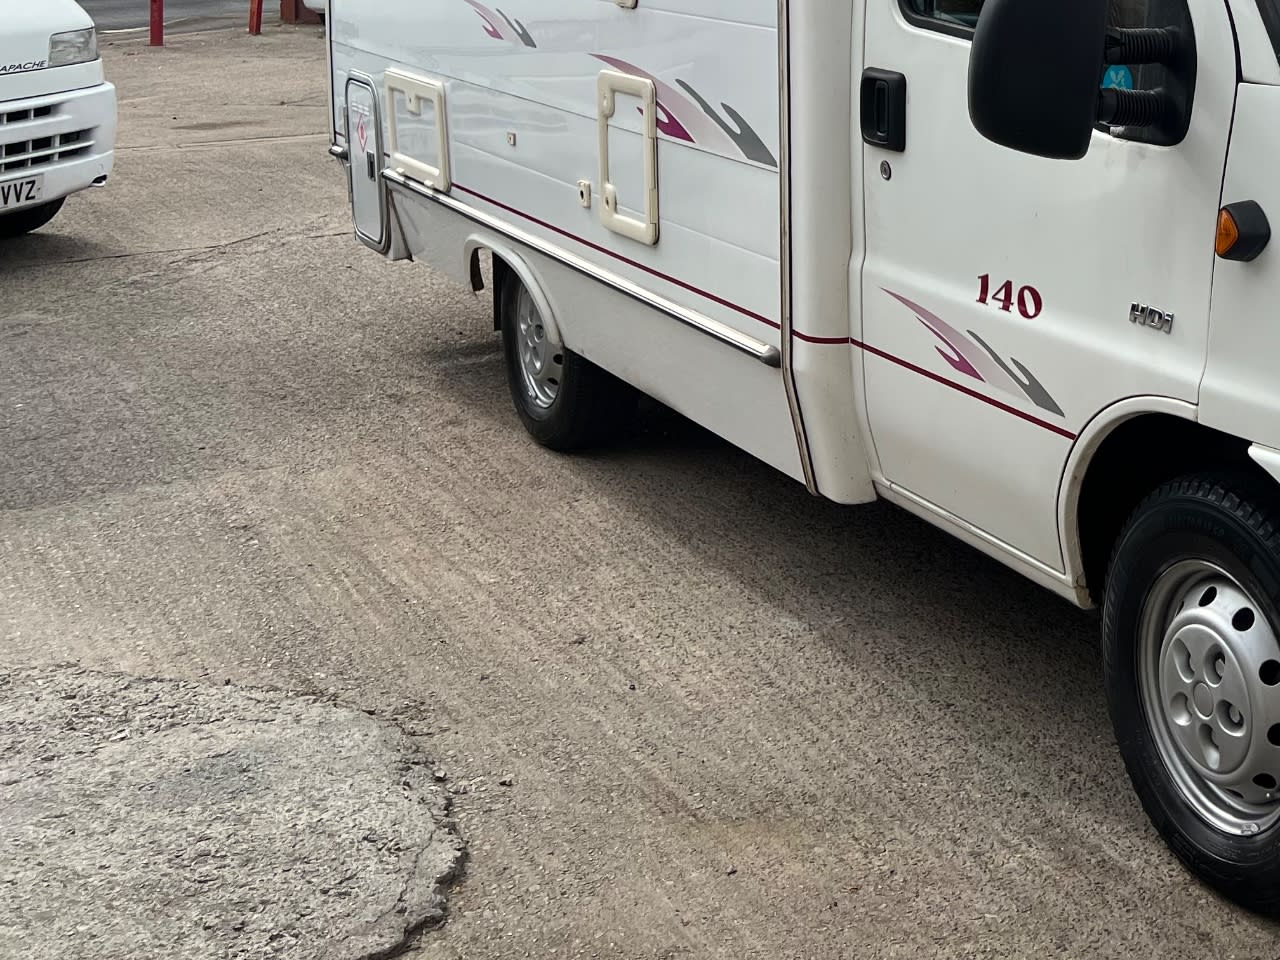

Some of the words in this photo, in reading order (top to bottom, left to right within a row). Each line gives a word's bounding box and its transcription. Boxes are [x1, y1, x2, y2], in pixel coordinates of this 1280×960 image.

[0, 60, 47, 72] APACHE
[1, 180, 36, 205] VVZ
[976, 273, 1043, 319] 140
[1128, 301, 1175, 334] HDi
